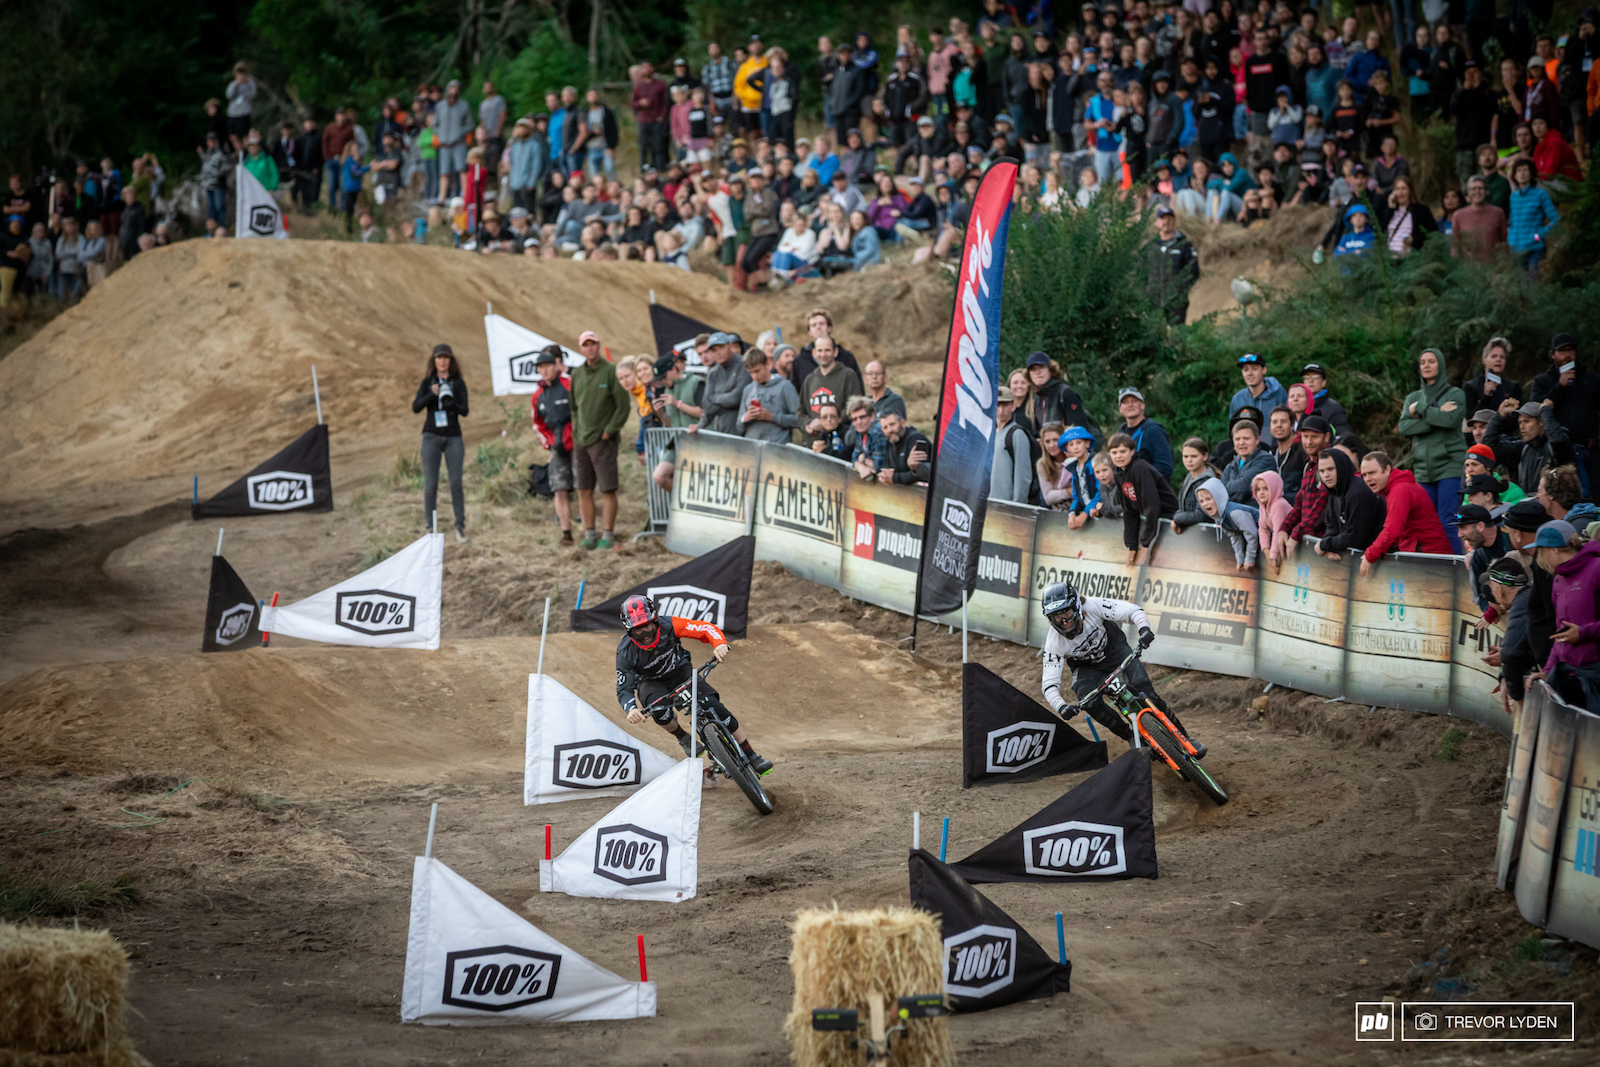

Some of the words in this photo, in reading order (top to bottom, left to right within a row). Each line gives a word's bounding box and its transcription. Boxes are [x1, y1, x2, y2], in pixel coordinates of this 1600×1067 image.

[955, 214, 993, 442] 100%
[257, 480, 305, 502] 100%
[678, 458, 749, 521] CAMELBAK
[763, 471, 843, 544] CAMELBAK
[946, 506, 970, 531] 100%
[856, 522, 873, 546] pb
[937, 529, 969, 555] WELCOME
[932, 549, 966, 580] RACING
[1060, 570, 1130, 600] TRANSDIESEL
[1165, 582, 1250, 615] TRANSDIESEL
[347, 601, 405, 625] 100%
[658, 597, 715, 622] 100%
[1422, 639, 1450, 657] TRUST
[997, 732, 1048, 764] 100%
[565, 753, 630, 780] 100%
[602, 838, 656, 871] 100%
[1038, 835, 1111, 867] 100%
[953, 941, 1008, 982] 100%
[459, 963, 547, 996] 100%
